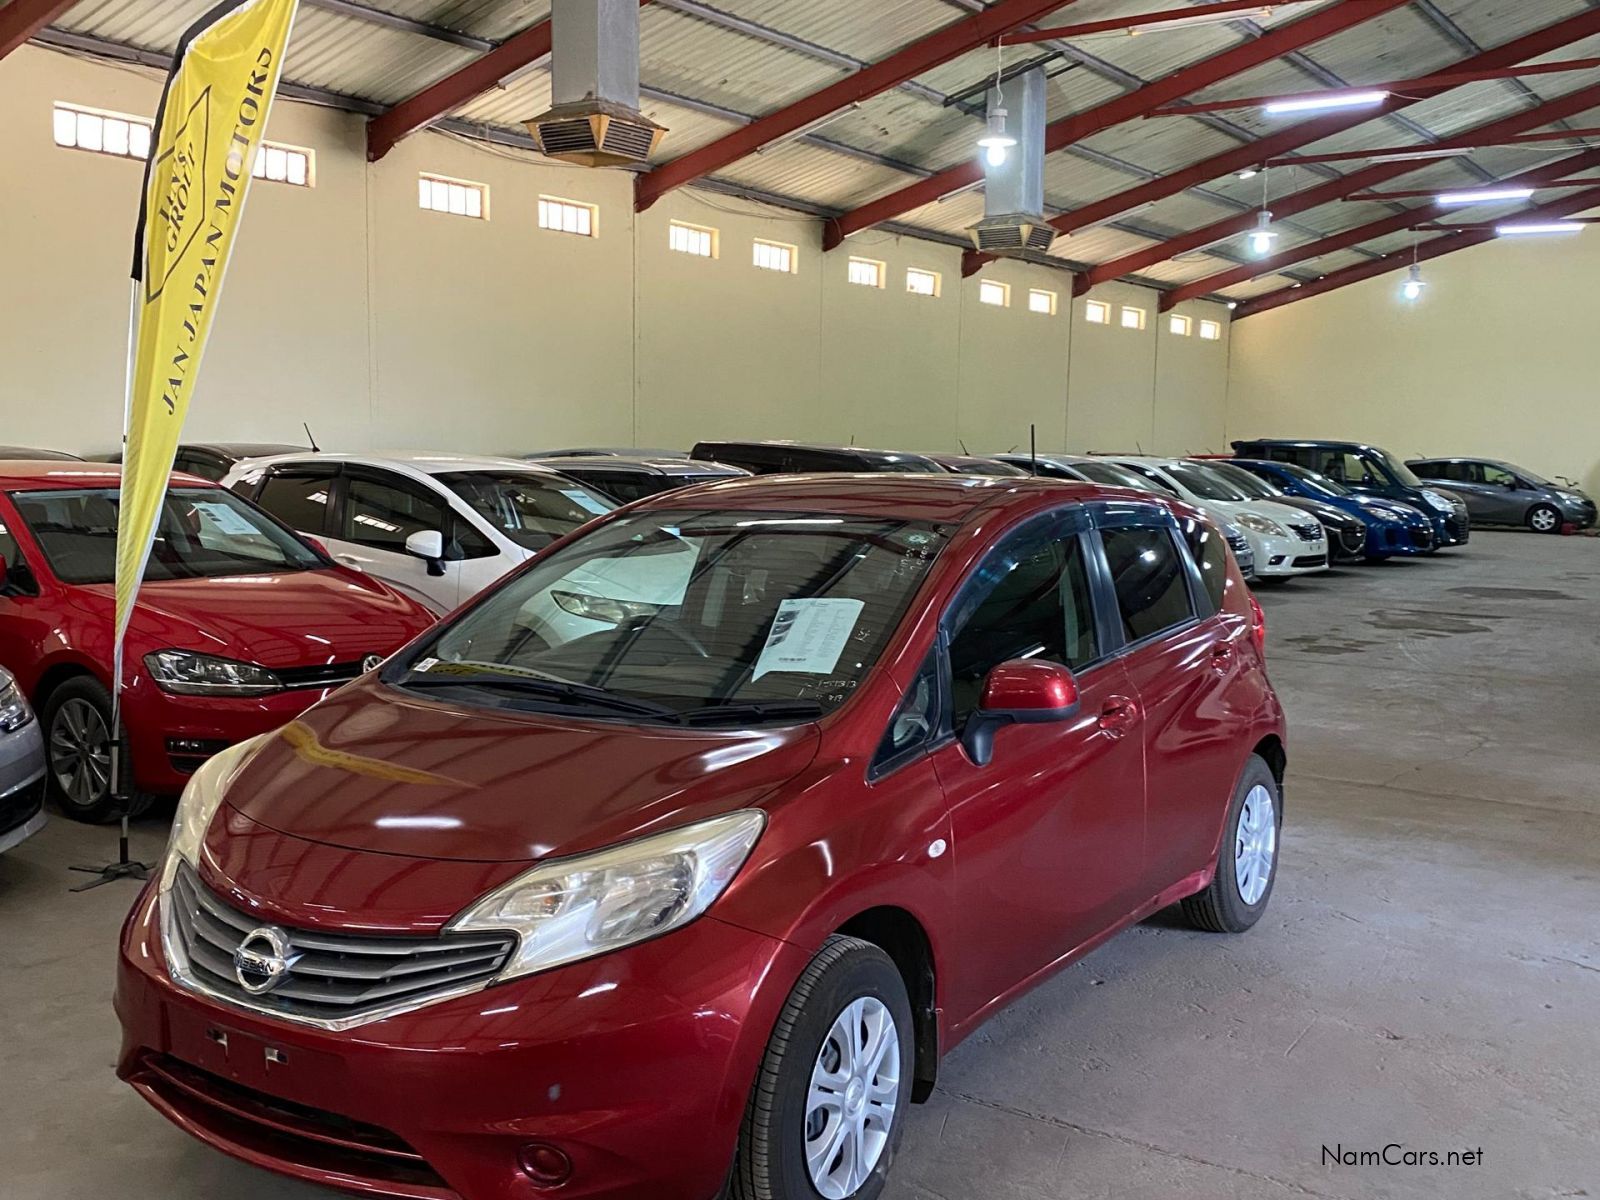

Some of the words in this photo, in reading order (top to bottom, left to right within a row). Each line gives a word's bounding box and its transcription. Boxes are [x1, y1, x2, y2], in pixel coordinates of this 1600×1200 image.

[162, 345, 189, 416] JAN
[183, 224, 223, 342] JAPAN
[215, 47, 272, 215] MOTORS
